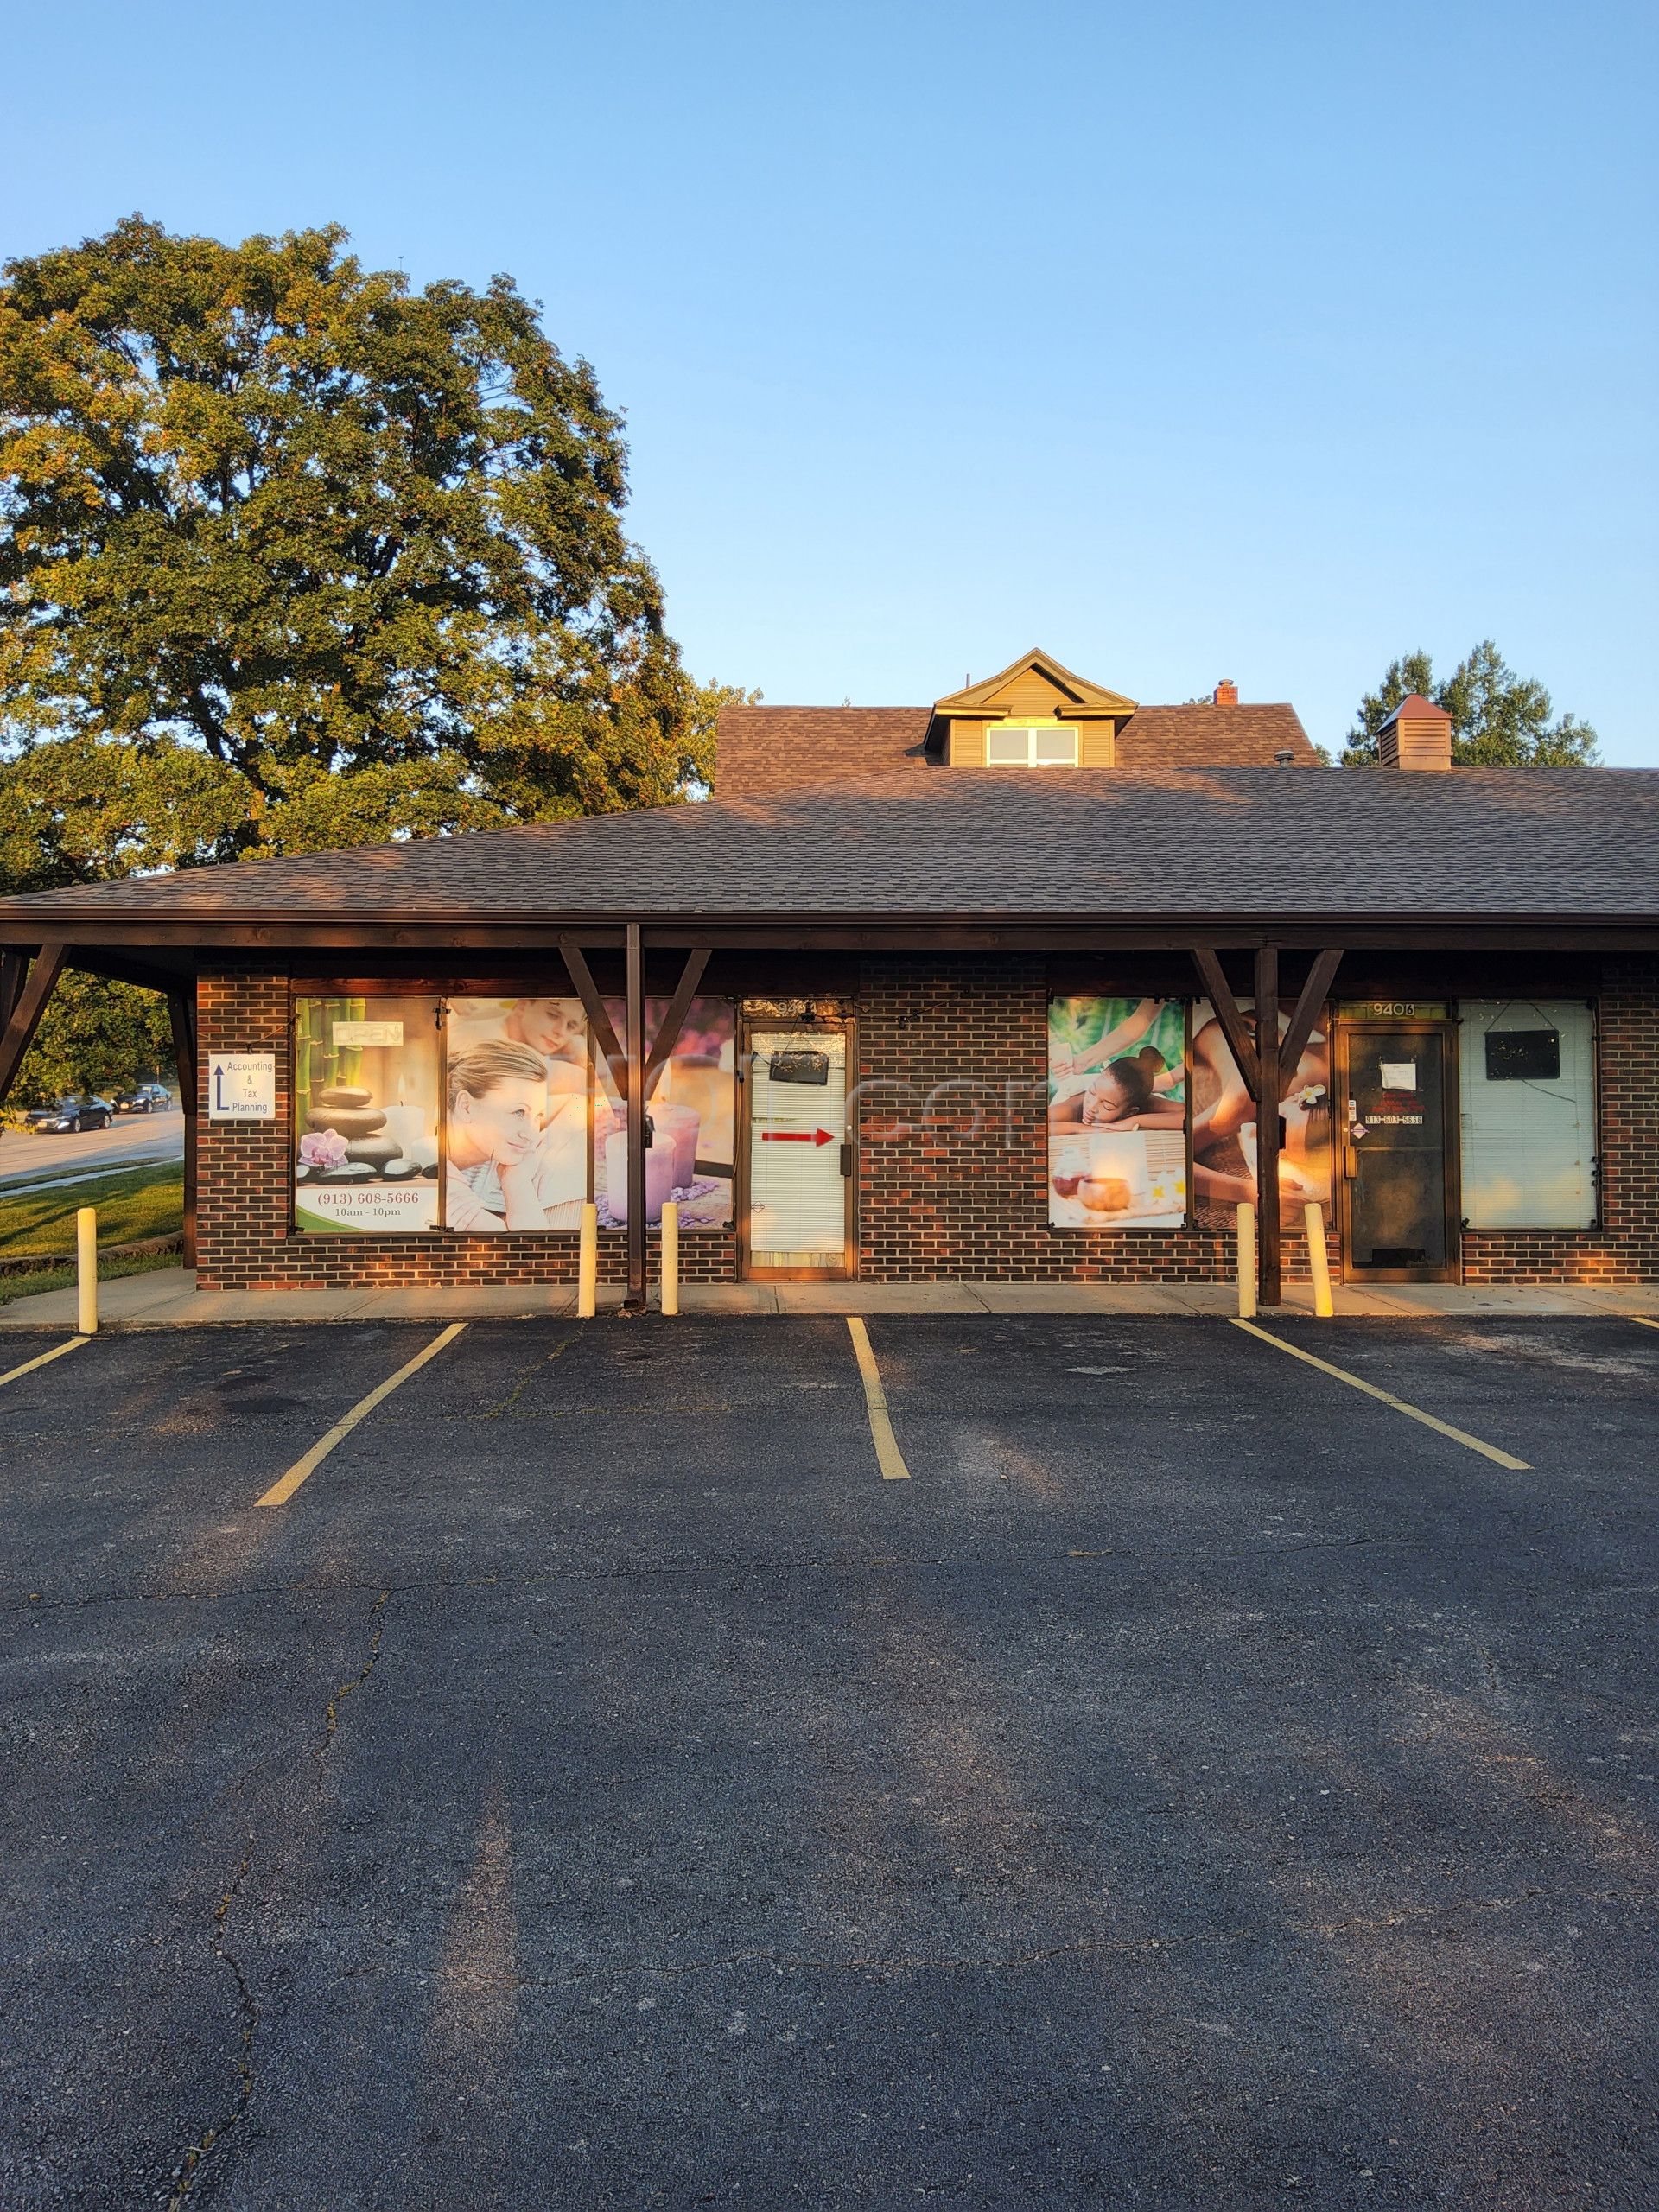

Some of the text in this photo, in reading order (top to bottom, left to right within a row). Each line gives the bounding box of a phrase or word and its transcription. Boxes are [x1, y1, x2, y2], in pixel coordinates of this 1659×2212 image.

[1373, 1002, 1414, 1016] 9406
[227, 1061, 273, 1073] Accounting
[246, 1074, 252, 1084] &
[242, 1088, 257, 1098] Tax
[232, 1102, 268, 1114] Planning
[1365, 1116, 1422, 1124] 913-608-5666
[318, 1192, 419, 1206] (913) 608-5666
[335, 1208, 363, 1217] 10am
[373, 1207, 402, 1217] 10pm
